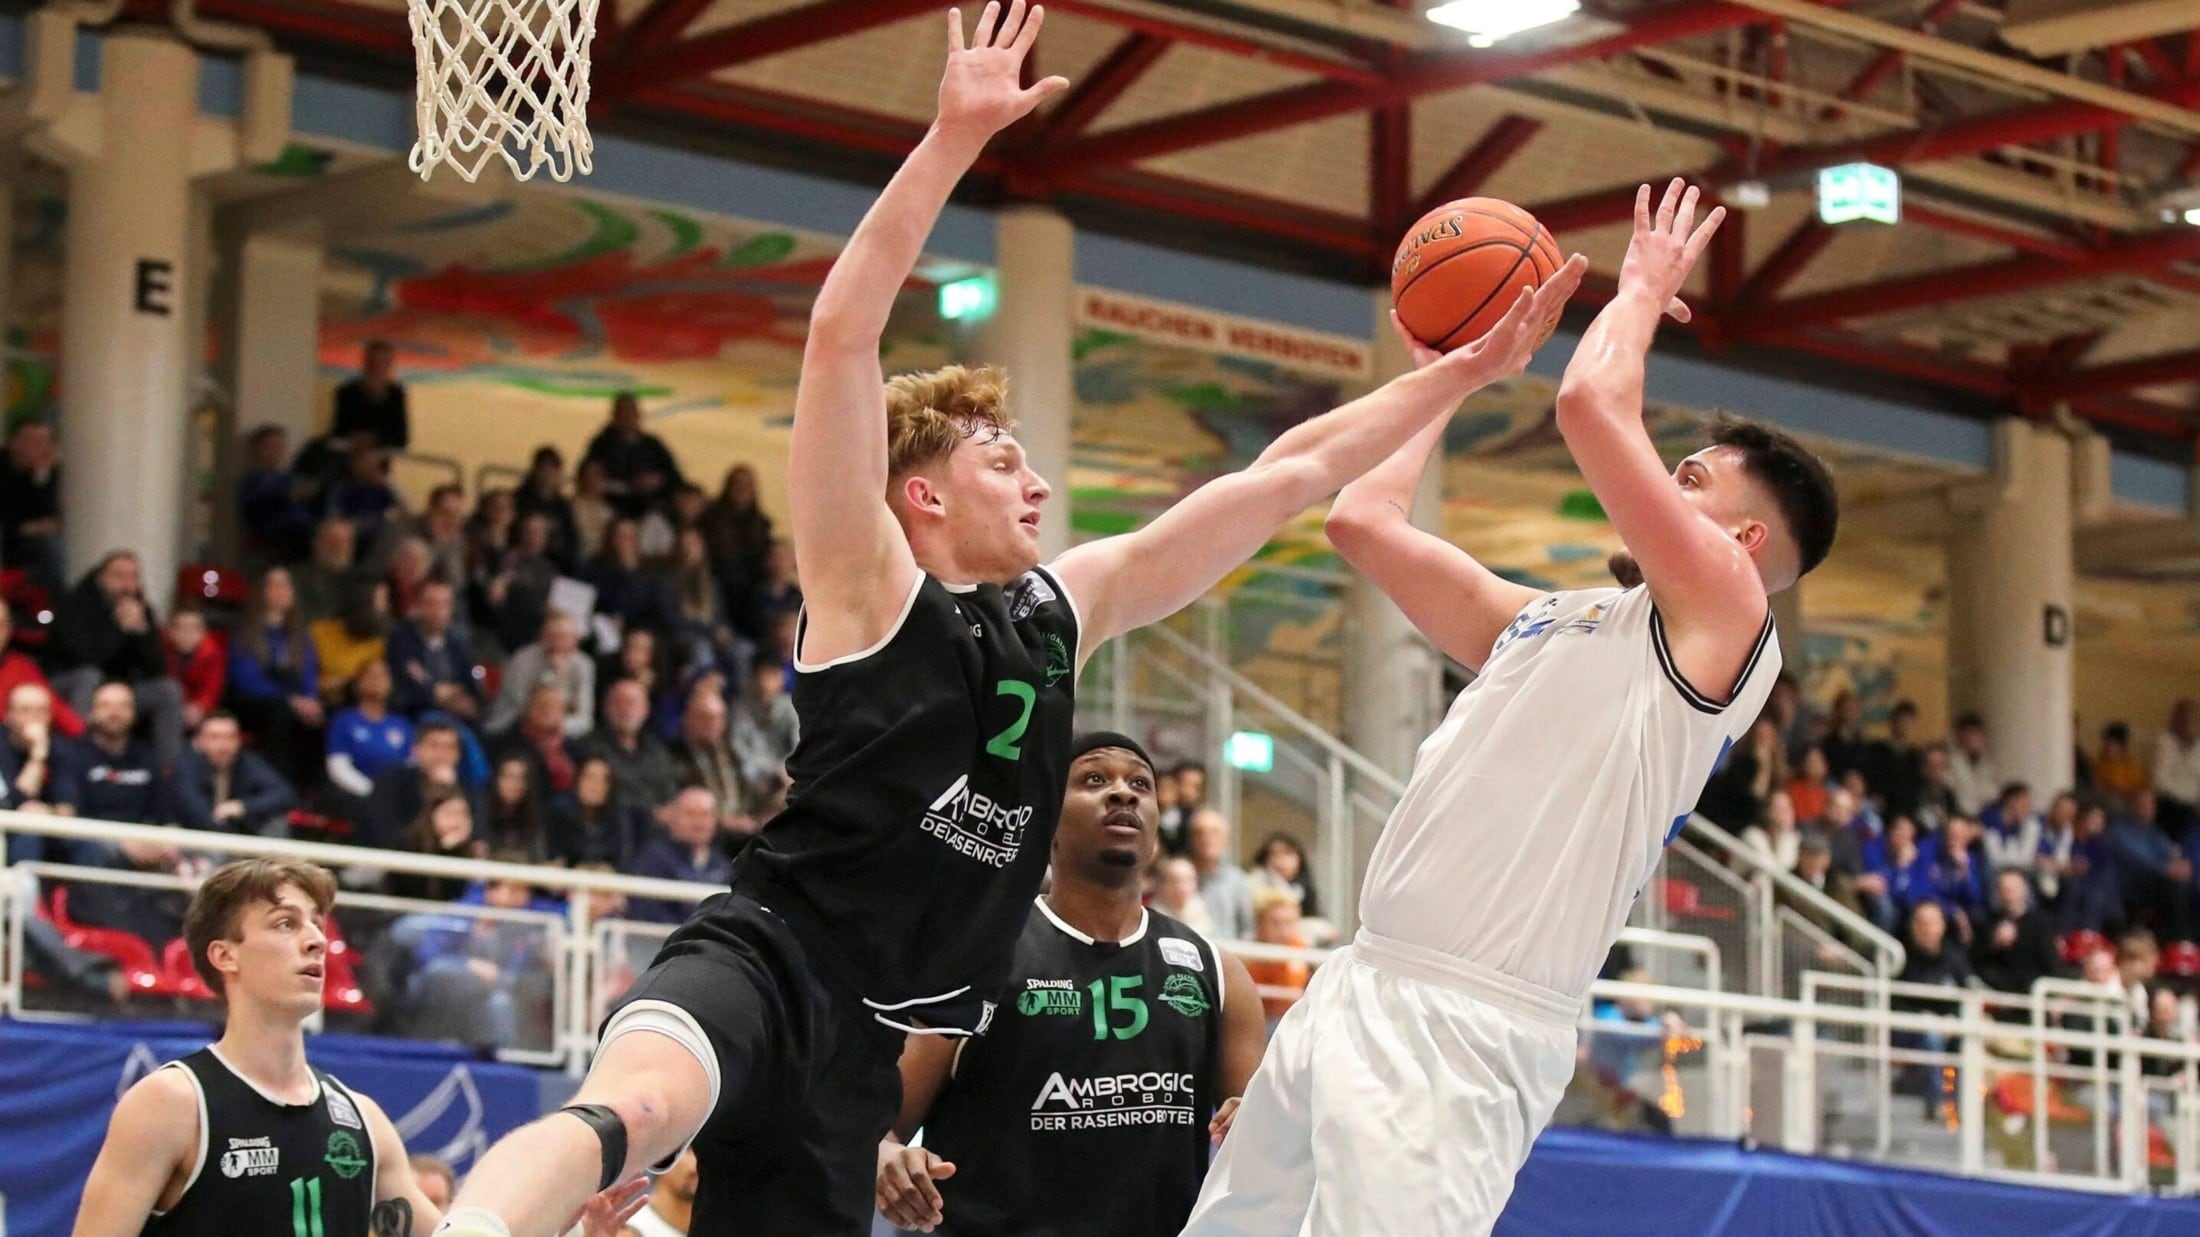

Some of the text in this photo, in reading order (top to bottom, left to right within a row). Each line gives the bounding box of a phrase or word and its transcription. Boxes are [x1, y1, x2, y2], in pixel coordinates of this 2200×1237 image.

[135, 259, 172, 316] E
[1087, 296, 1362, 371] RAUCHEN VERBOTEN
[2043, 604, 2068, 647] D
[986, 679, 1037, 761] 2
[920, 817, 951, 841] DE
[1026, 979, 1074, 990] SPALDING
[1046, 1007, 1081, 1016] SPORT
[1047, 991, 1079, 1008] MM
[1087, 975, 1149, 1040] 15
[1031, 1117, 1067, 1131] DER
[247, 1150, 277, 1166] MM
[247, 1166, 278, 1177] SPORT
[289, 1176, 324, 1237] 11
